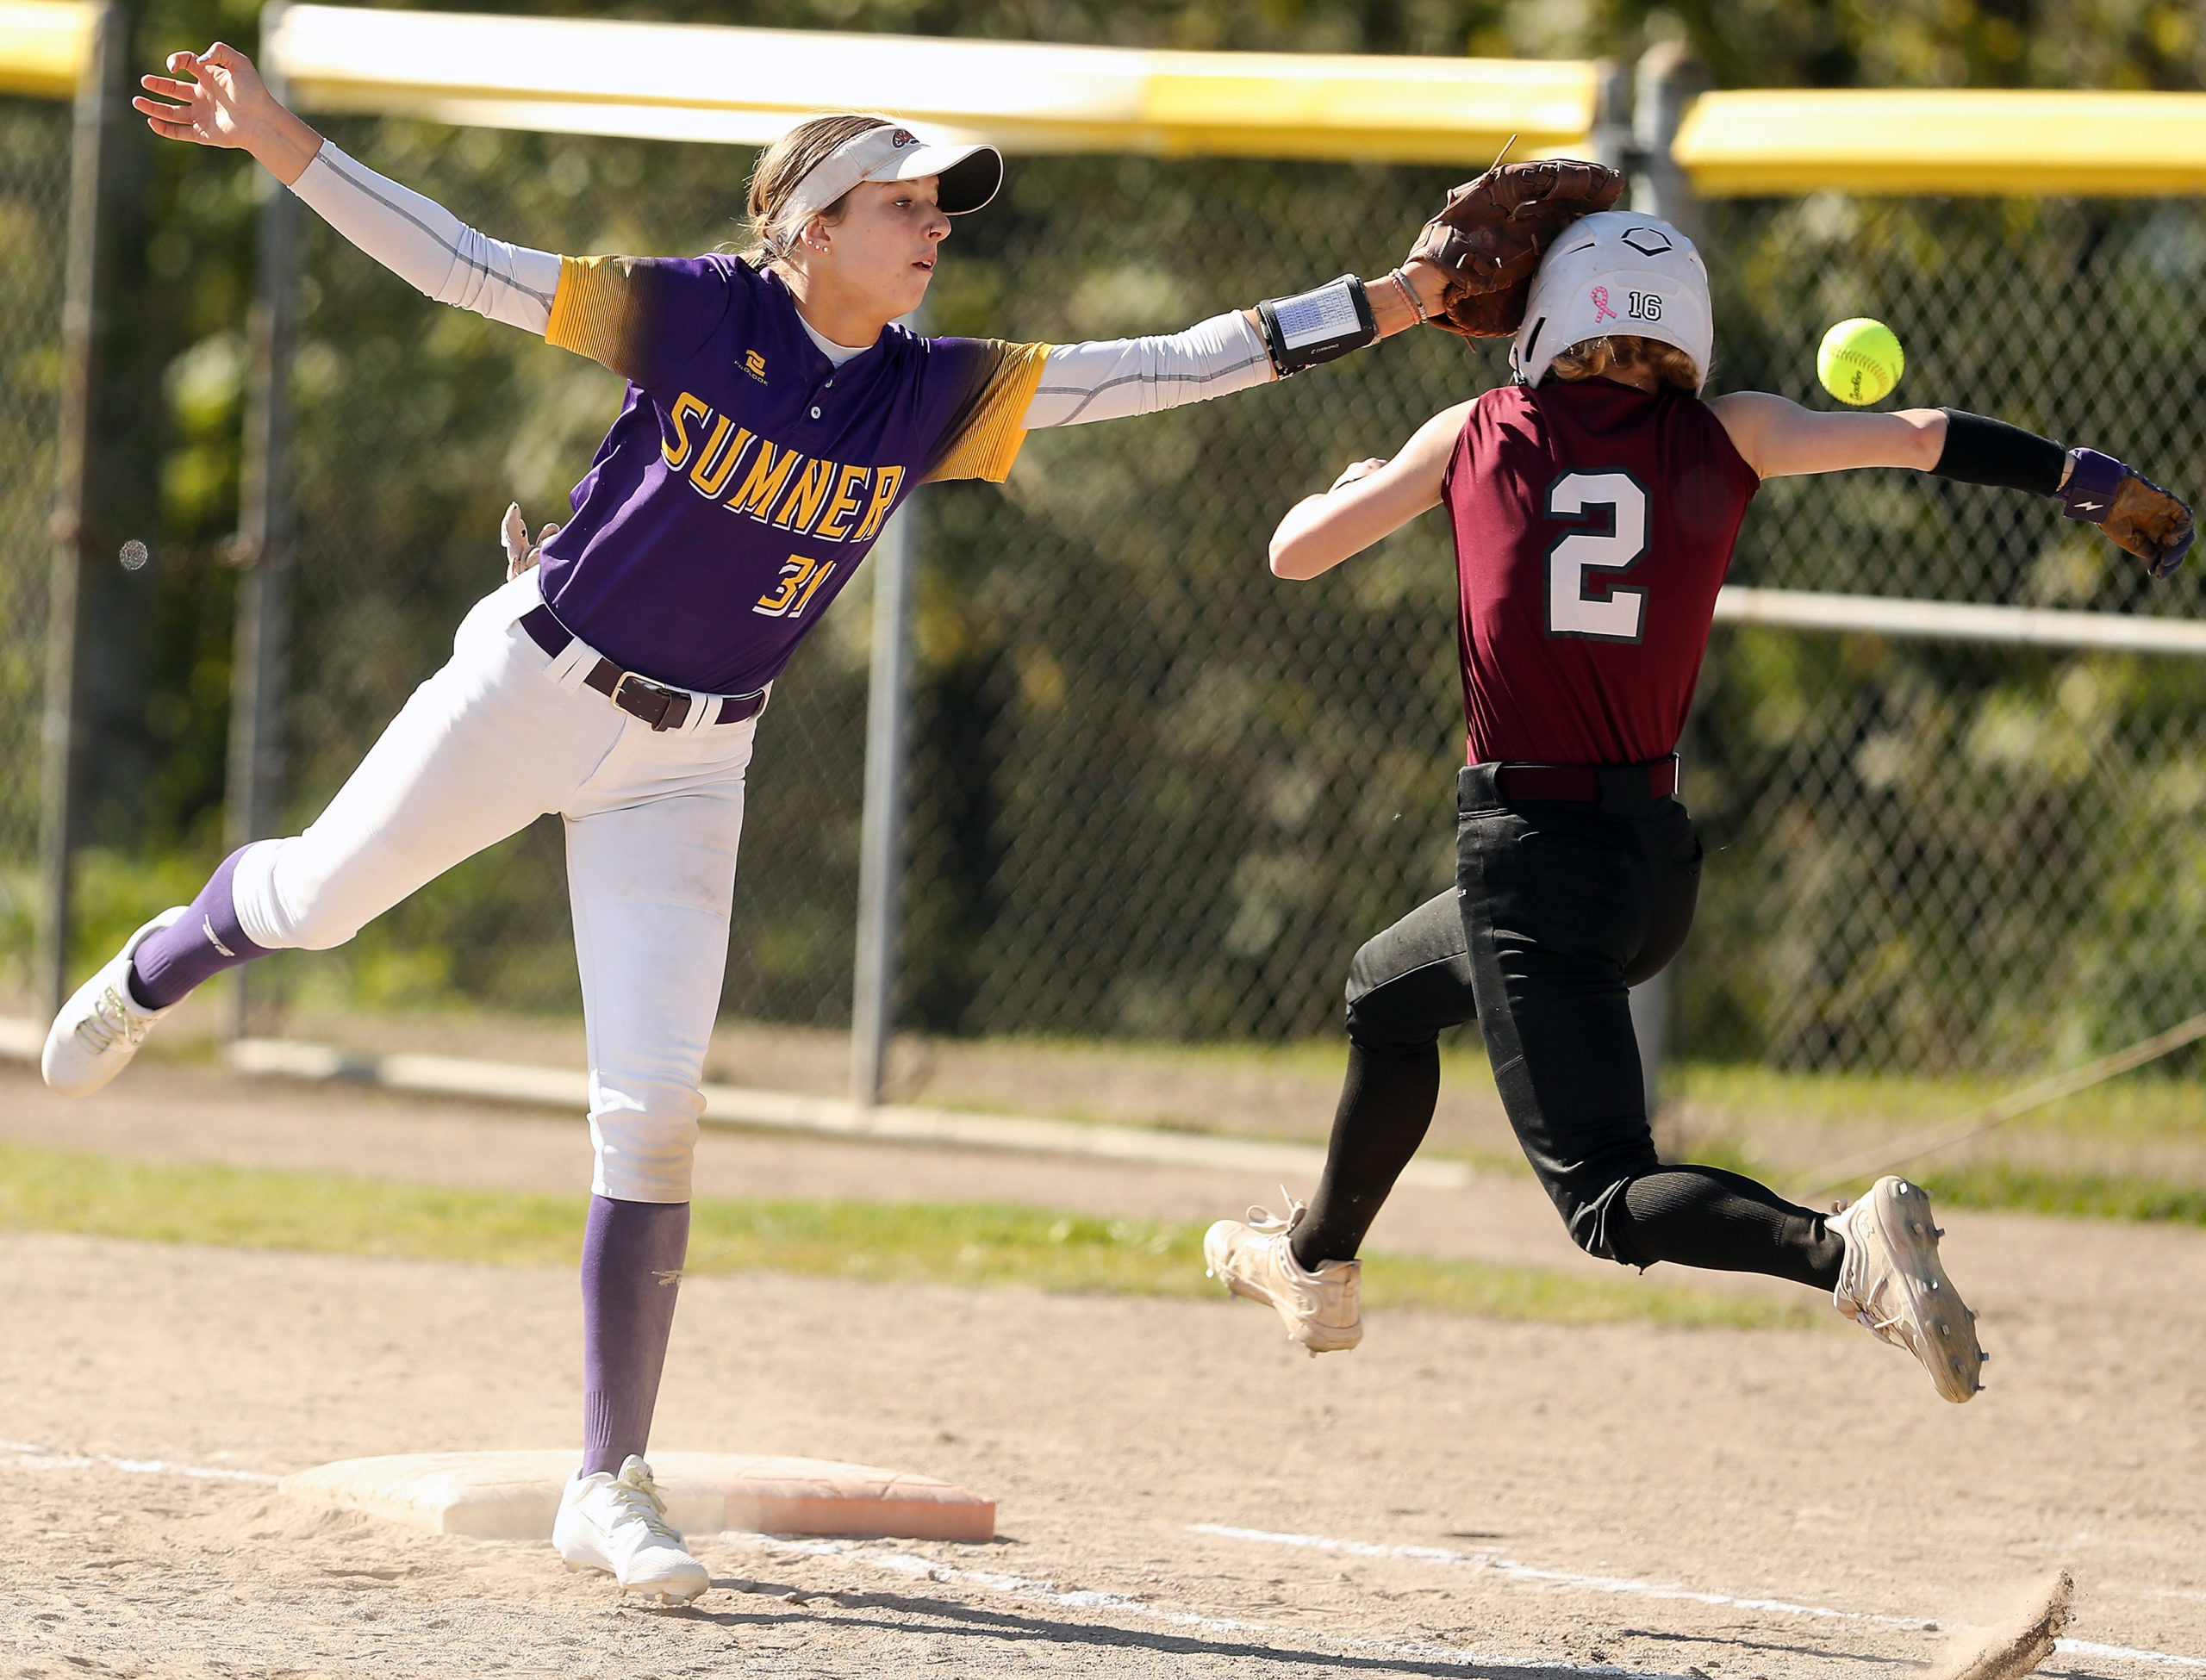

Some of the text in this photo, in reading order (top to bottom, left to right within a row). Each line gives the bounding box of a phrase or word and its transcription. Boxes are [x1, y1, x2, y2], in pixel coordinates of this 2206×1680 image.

[1629, 291, 1662, 321] 16
[661, 392, 906, 543] SUMNER
[752, 554, 837, 618] 31
[1543, 467, 1652, 644] 2
